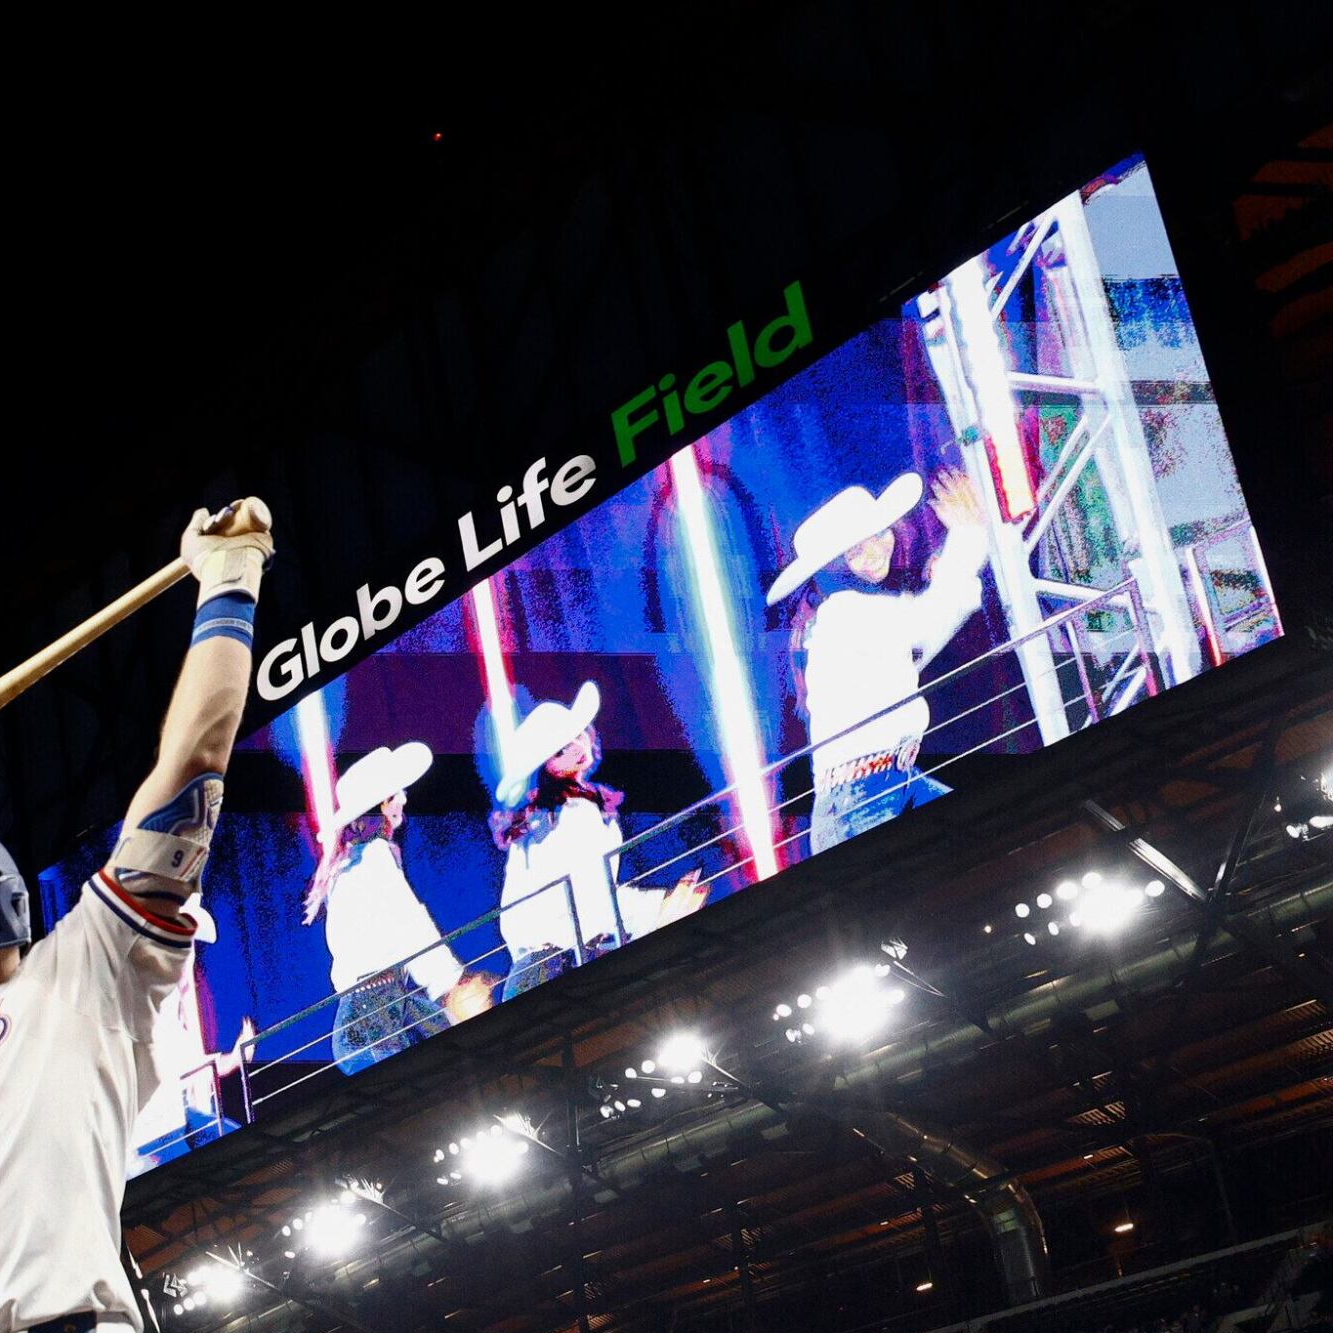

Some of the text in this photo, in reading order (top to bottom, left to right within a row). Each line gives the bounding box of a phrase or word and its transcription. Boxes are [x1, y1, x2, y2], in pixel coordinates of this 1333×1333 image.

[257, 280, 815, 701] Globe Life Field
